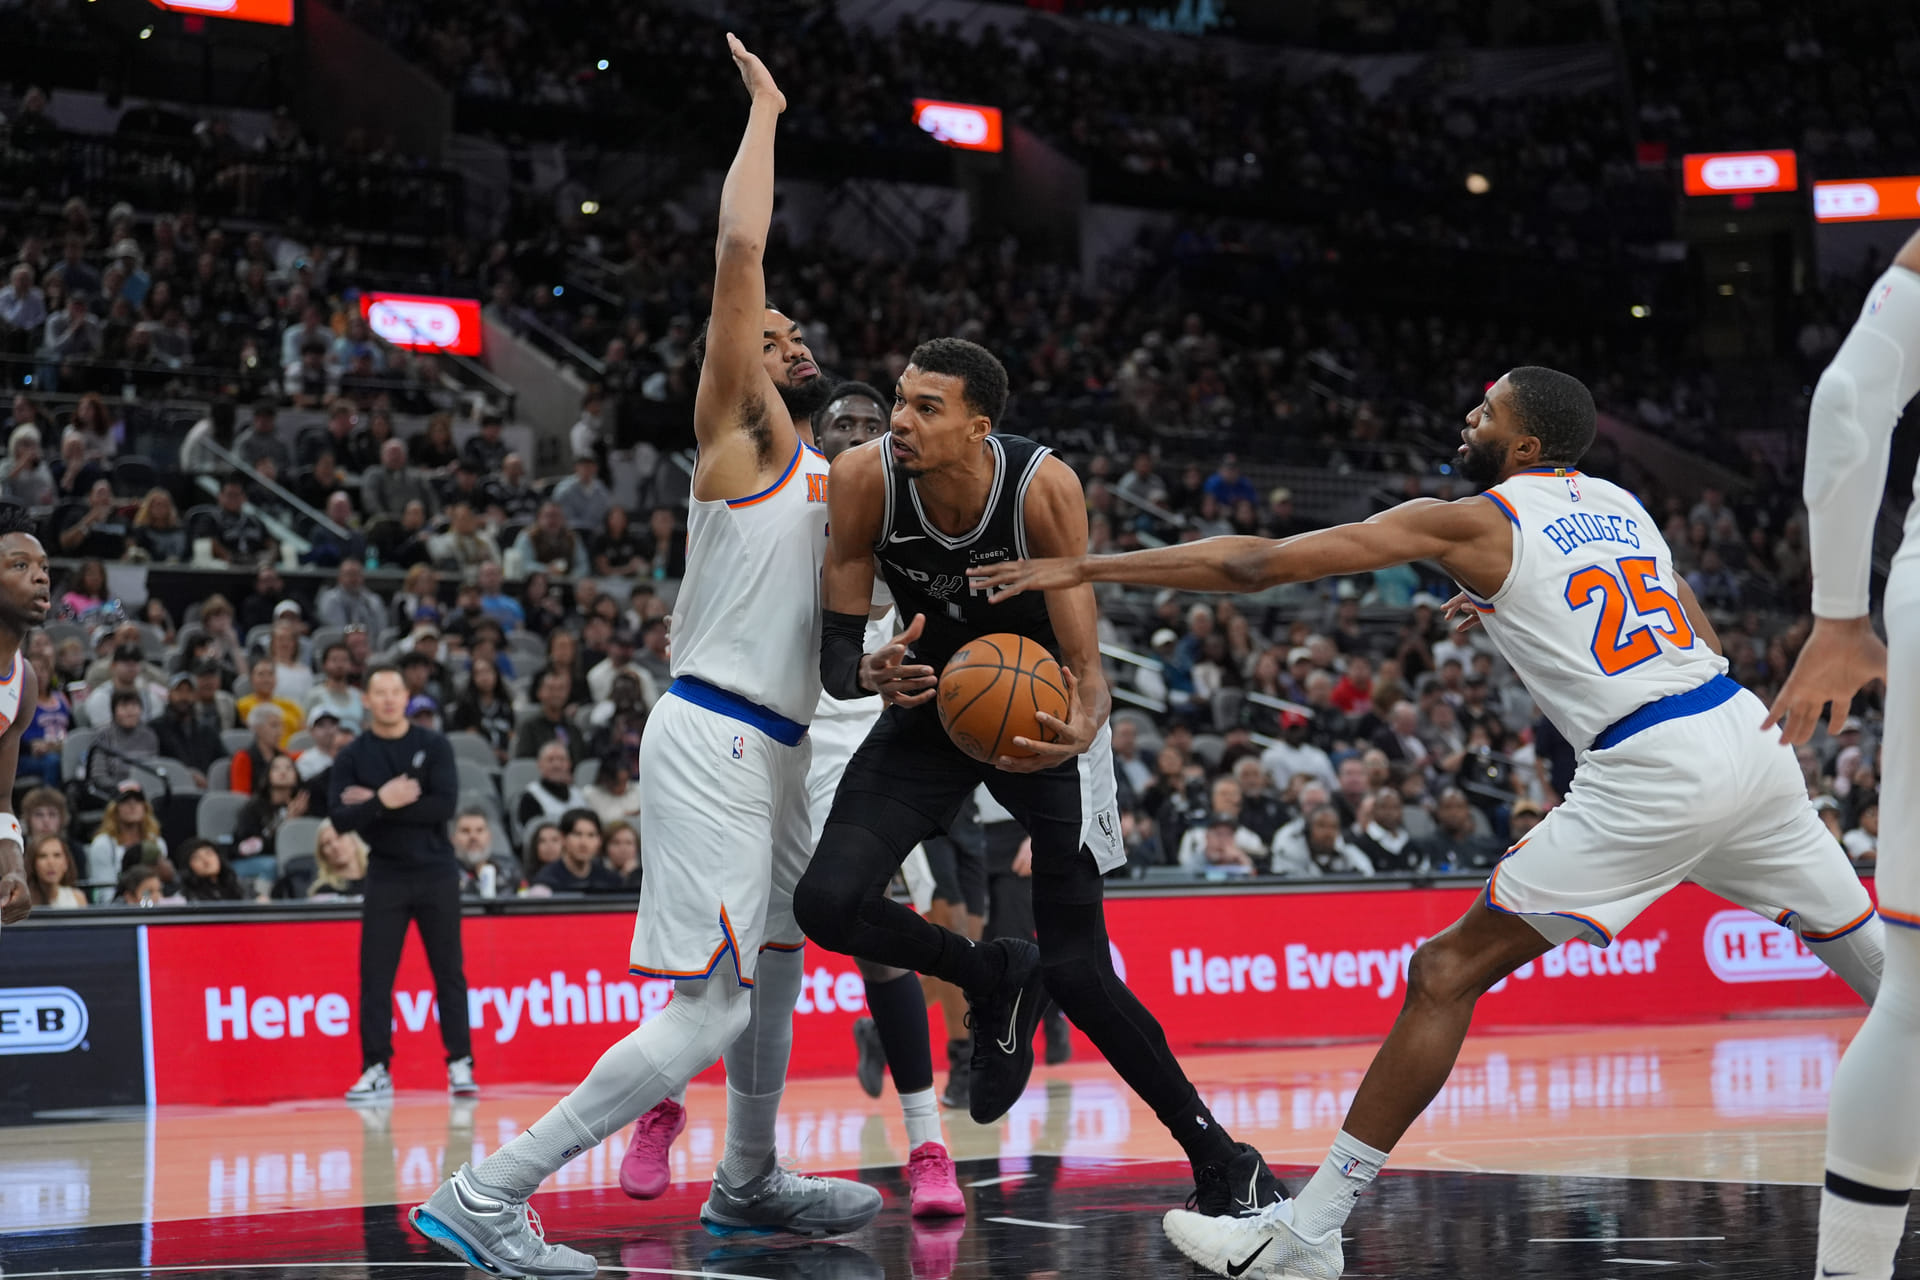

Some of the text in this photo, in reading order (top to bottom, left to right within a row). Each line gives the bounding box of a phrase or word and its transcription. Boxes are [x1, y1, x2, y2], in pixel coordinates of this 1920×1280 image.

[974, 550, 1004, 560] LEDGER
[1542, 512, 1640, 555] BRIDGES
[1564, 556, 1694, 676] 25
[1170, 947, 1277, 995] Here
[204, 985, 350, 1041] Here
